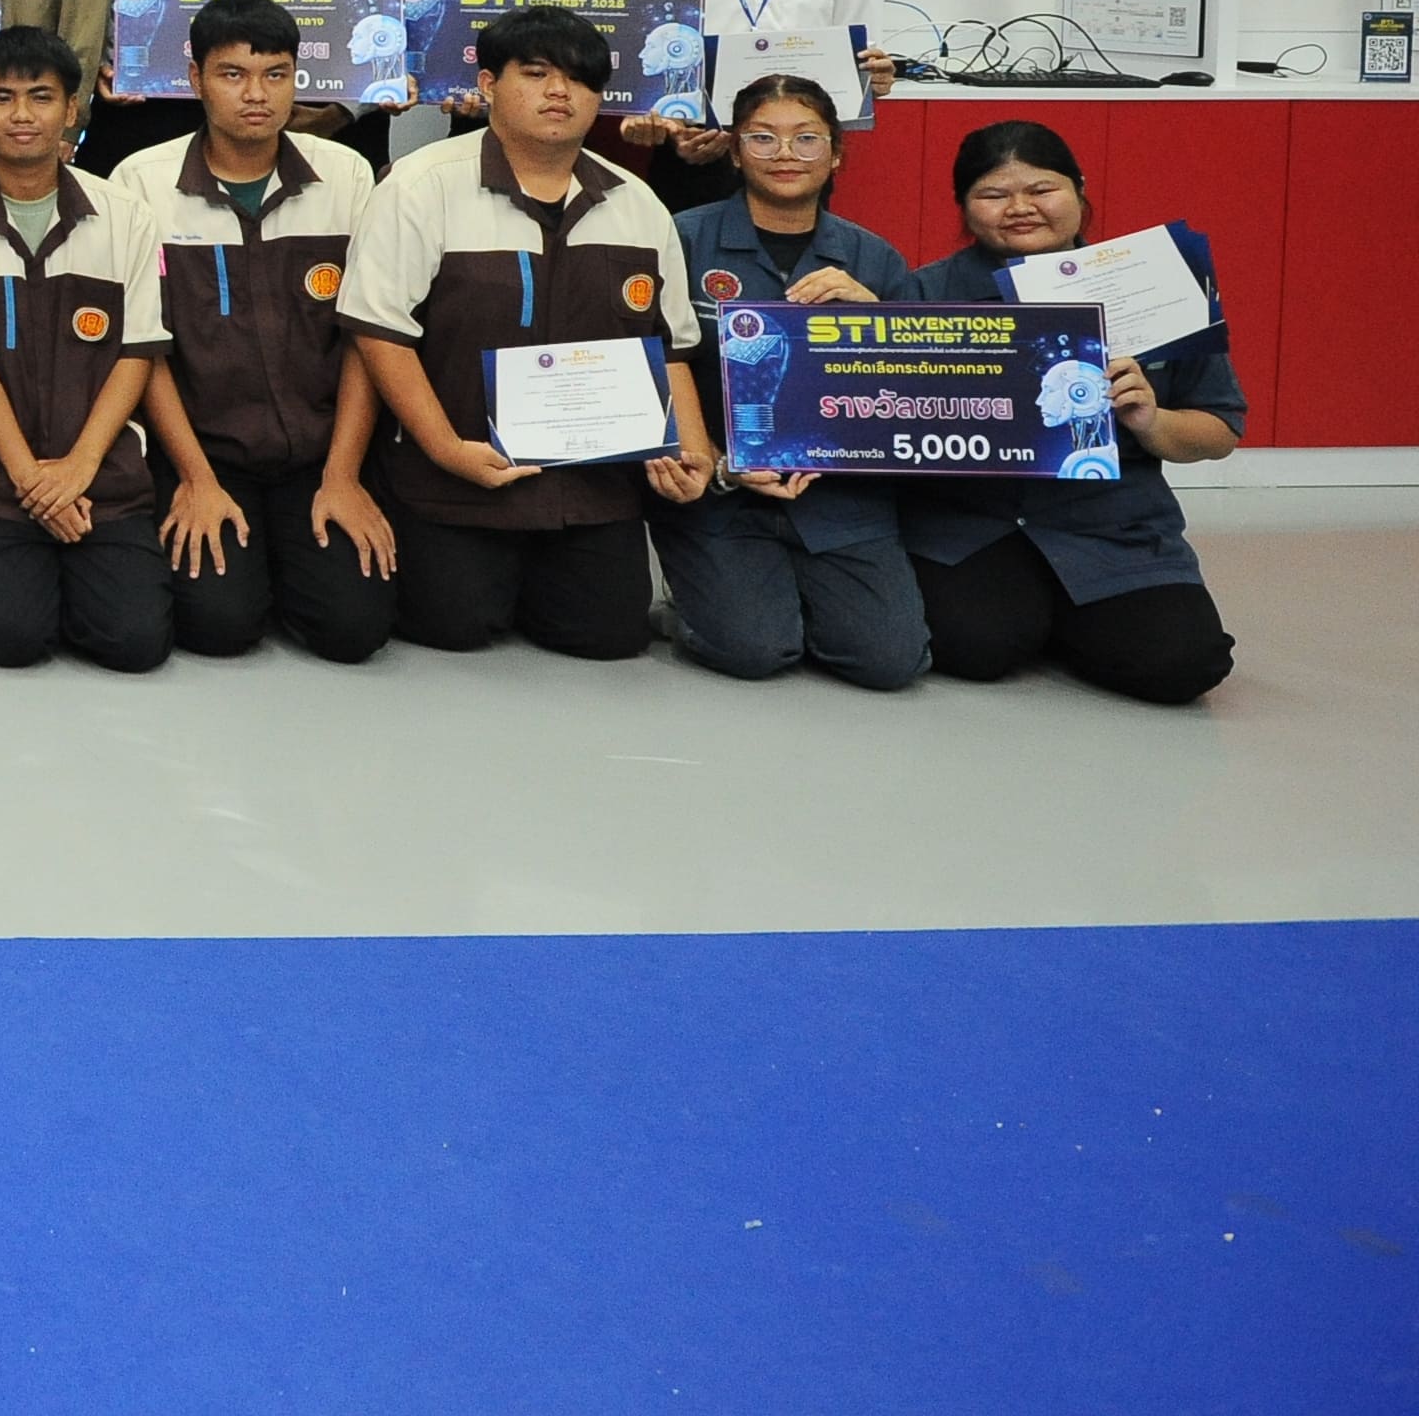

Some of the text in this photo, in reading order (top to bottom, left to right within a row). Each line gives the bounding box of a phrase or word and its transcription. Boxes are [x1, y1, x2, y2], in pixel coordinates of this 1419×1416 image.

[316, 80, 343, 90] บาท
[603, 90, 632, 102] บาท
[807, 316, 885, 342] STI
[891, 317, 1015, 331] INVENTIONS
[892, 331, 965, 343] CONTEST
[893, 434, 990, 464] 5,000
[999, 447, 1035, 462] บาท
